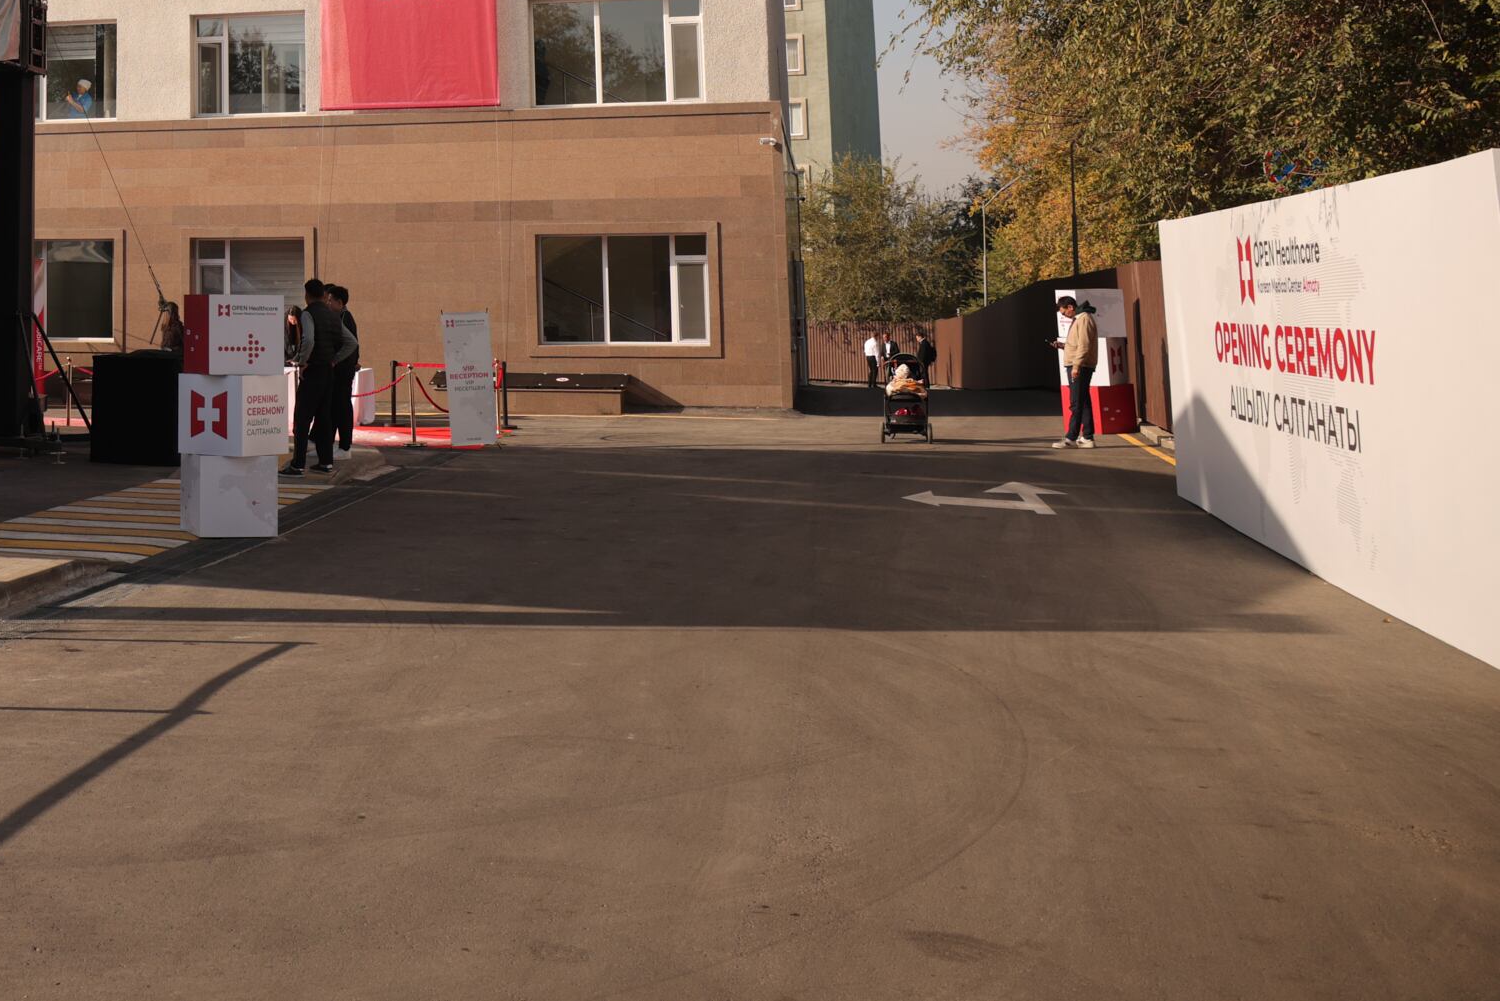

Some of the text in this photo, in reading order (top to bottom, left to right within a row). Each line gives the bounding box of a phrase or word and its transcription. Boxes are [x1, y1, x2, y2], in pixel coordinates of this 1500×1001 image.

[1253, 236, 1320, 268] OPEN Healthcare
[1215, 321, 1376, 385] OPENING CEREMONY
[246, 395, 278, 404] OPENING
[246, 406, 285, 416] CEREMONY
[1230, 385, 1362, 454] АШЫЛУ САЛТАНАТЫ
